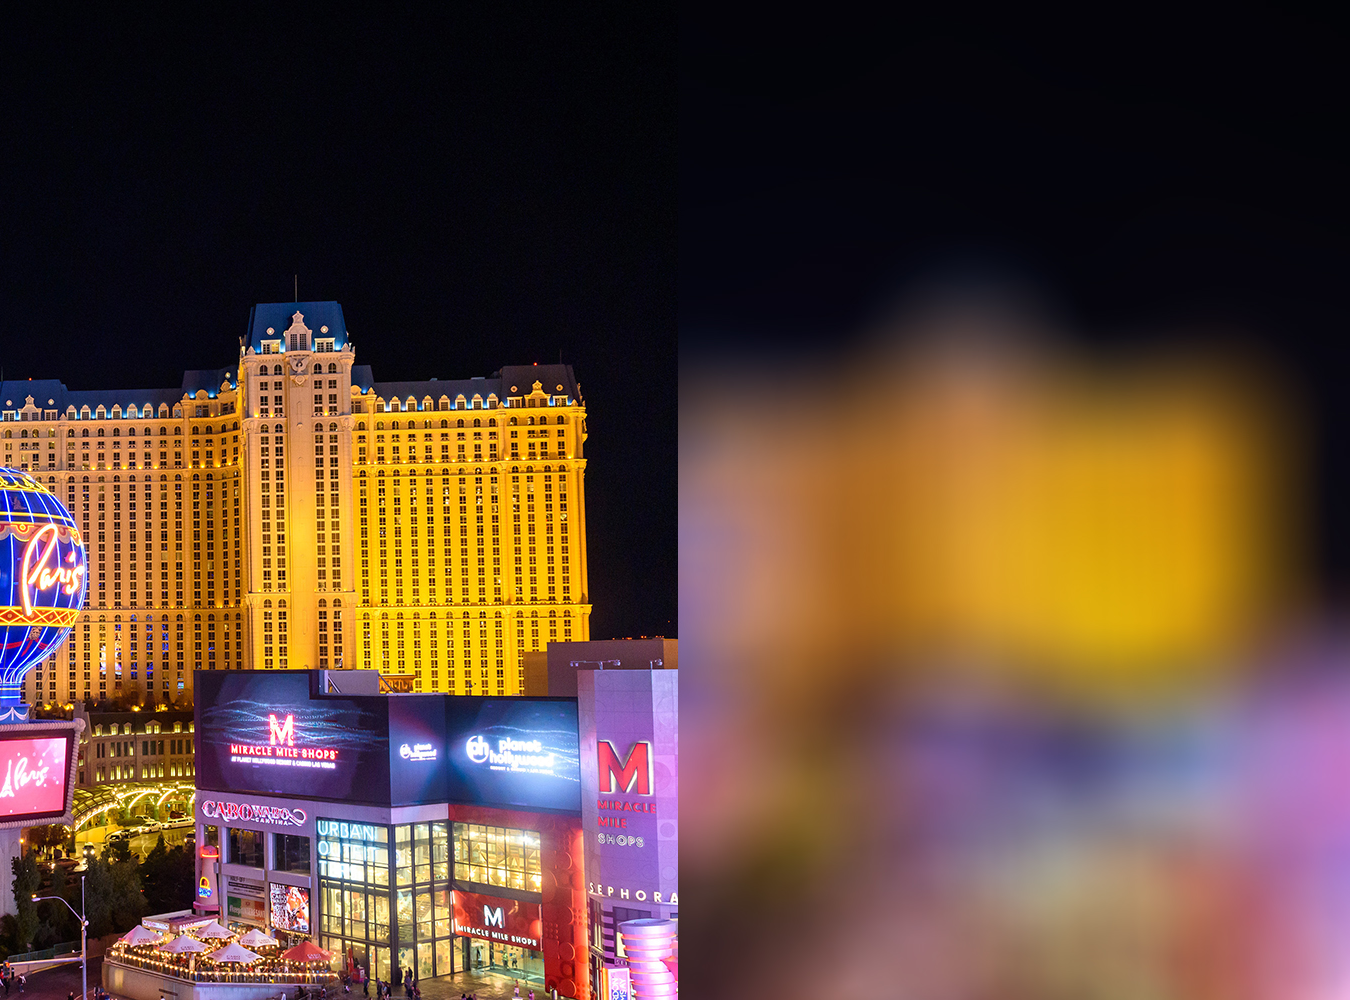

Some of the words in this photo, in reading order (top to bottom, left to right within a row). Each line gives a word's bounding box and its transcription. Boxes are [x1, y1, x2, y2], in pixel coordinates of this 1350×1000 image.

[21, 523, 85, 616] Paris
[269, 713, 294, 747] M
[230, 743, 272, 756] MIRACLE
[275, 747, 298, 758] MILE
[301, 748, 336, 760] SHOPS
[499, 737, 542, 753] planet
[489, 750, 555, 768] hollywood
[597, 740, 654, 796] M
[14, 757, 50, 790] Paris
[201, 800, 253, 823] CABO
[251, 804, 298, 822] WABO
[597, 799, 656, 814] MIRACLE
[255, 817, 288, 826] CANTINA
[317, 820, 375, 841] URBAN
[597, 816, 627, 829] MILE
[597, 833, 644, 848] SHOPS
[589, 882, 678, 903] SEPHORA
[483, 904, 505, 929] M
[457, 924, 489, 937] MIRACLE
[491, 931, 508, 941] MILE
[511, 935, 537, 946] SHOPS
